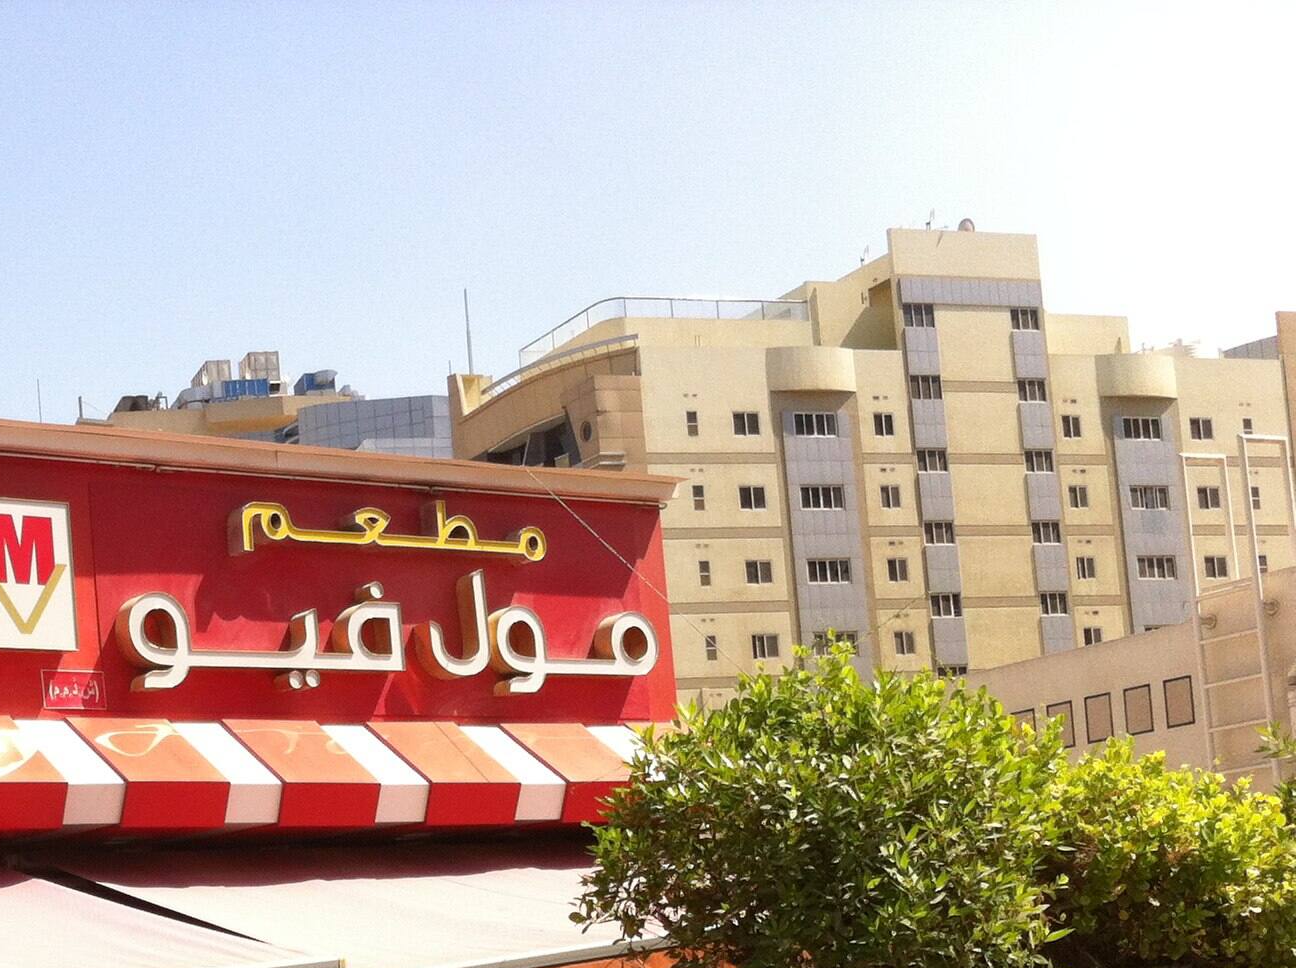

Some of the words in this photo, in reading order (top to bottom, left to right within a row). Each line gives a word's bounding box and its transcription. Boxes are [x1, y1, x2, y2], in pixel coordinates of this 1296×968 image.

[230, 500, 547, 564] مطعم
[118, 582, 406, 692] فيو
[416, 569, 659, 697] مول
